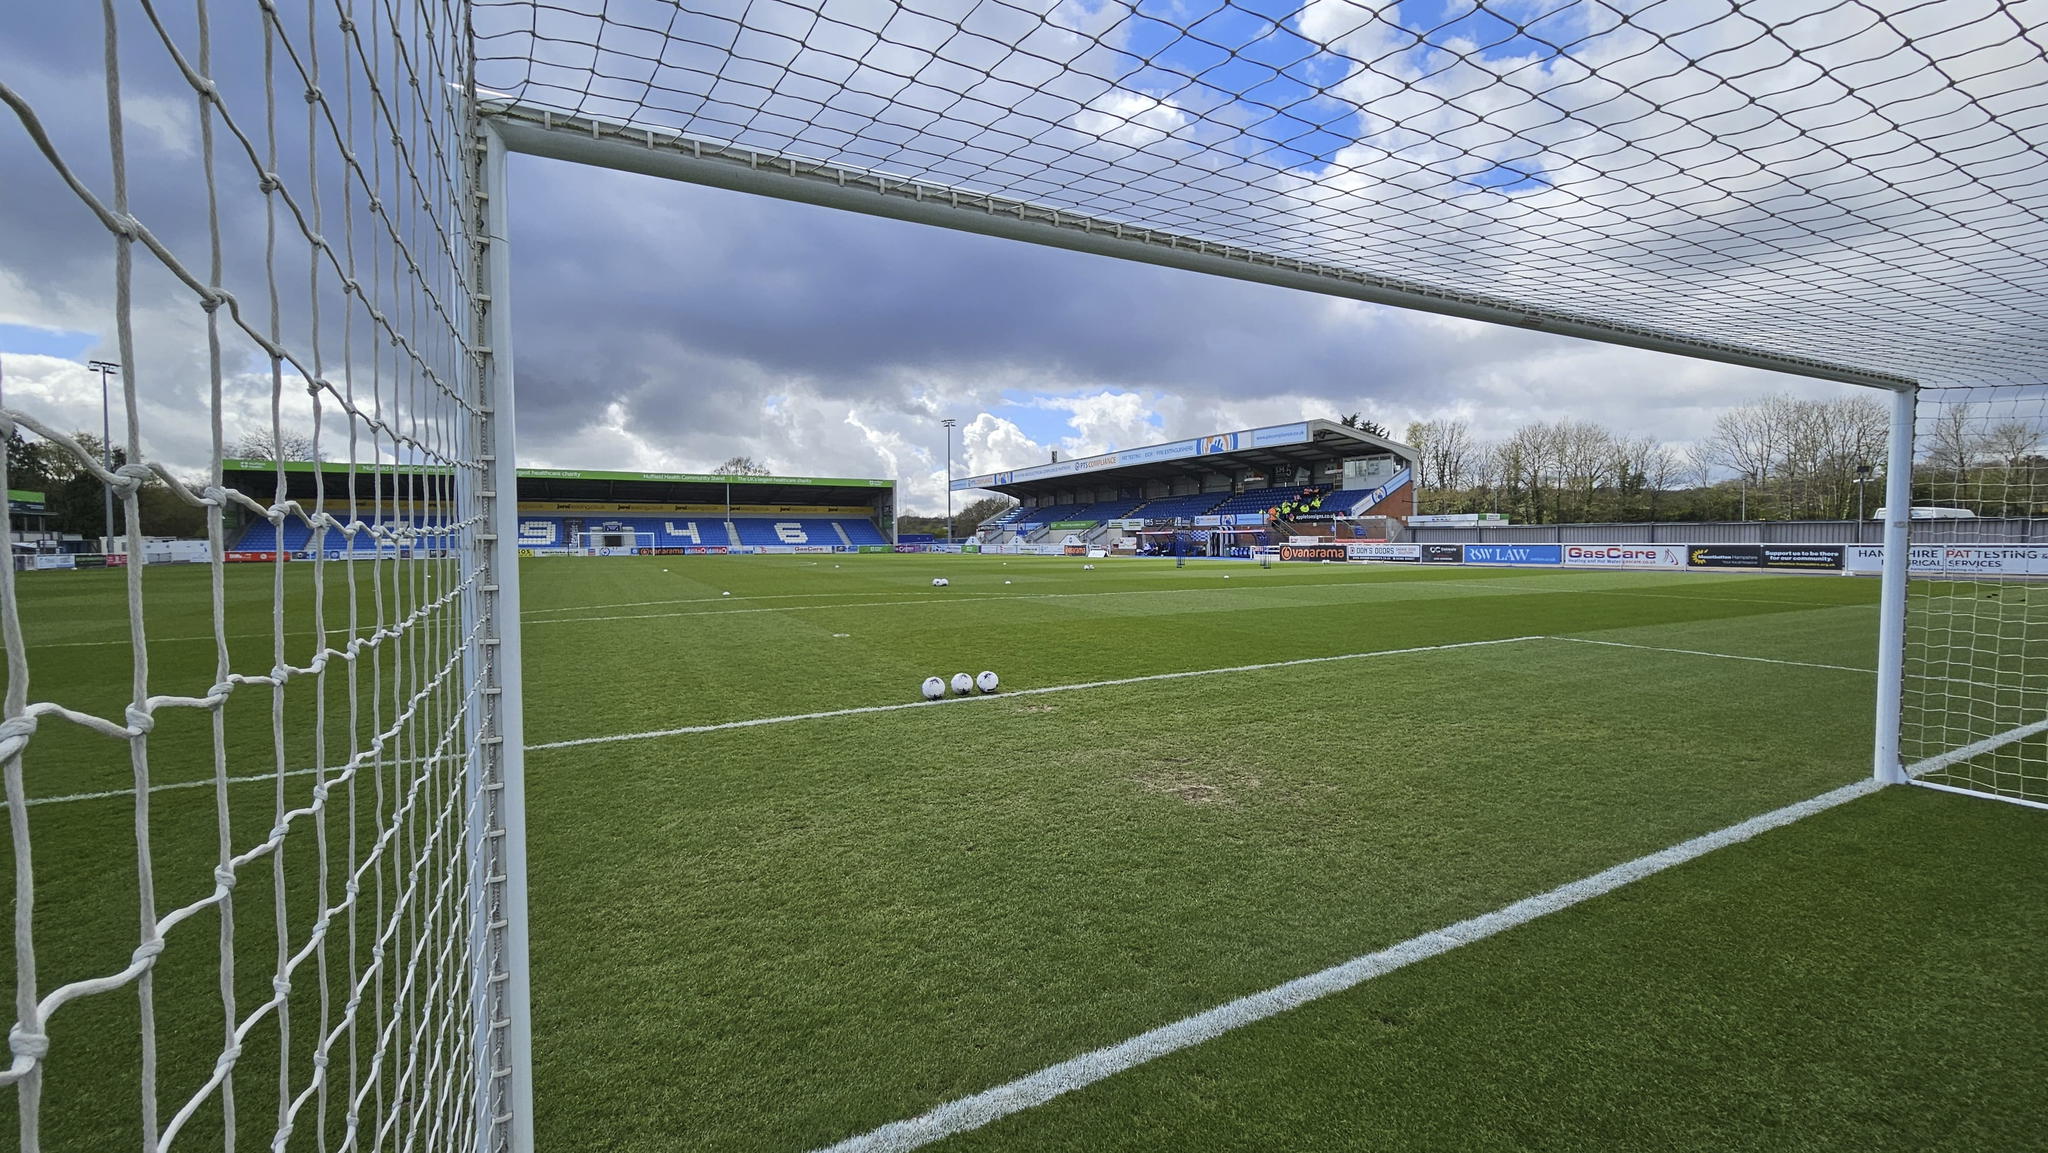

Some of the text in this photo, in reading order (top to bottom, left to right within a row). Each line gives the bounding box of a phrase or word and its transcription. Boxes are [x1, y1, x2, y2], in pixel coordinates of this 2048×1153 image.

[1292, 549, 1345, 558] vanarama
[1469, 548, 1492, 560] RSW
[1496, 548, 1530, 560] LAW
[1568, 547, 1657, 559] GasCare
[1945, 550, 1972, 558] PAT
[1974, 550, 2038, 559] TESTING
